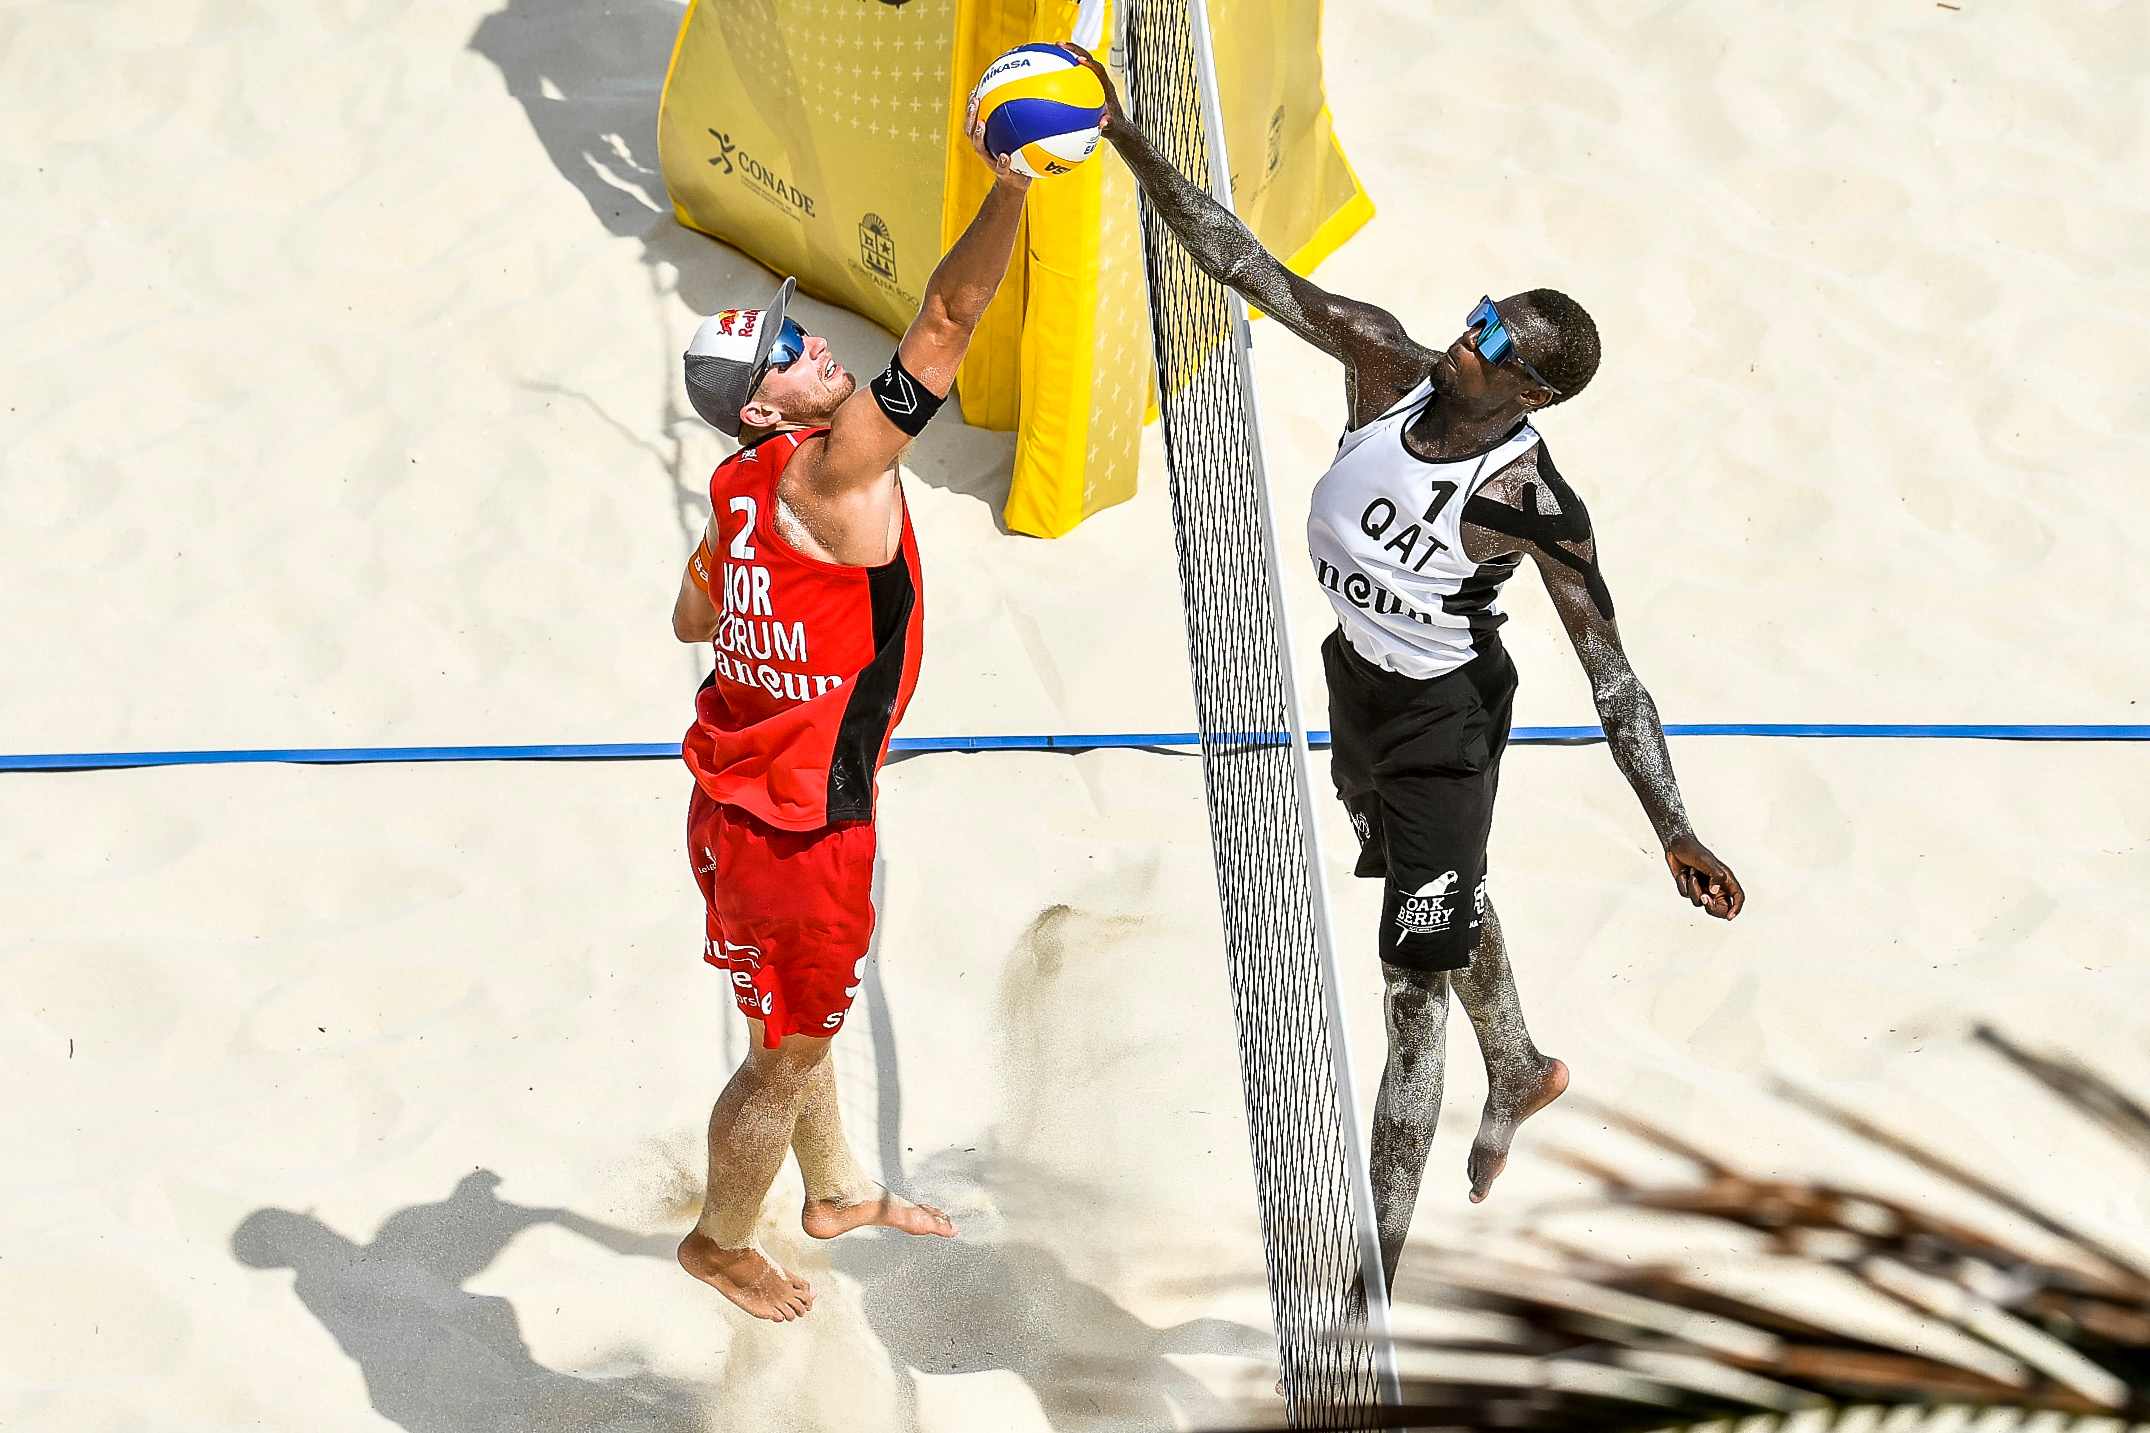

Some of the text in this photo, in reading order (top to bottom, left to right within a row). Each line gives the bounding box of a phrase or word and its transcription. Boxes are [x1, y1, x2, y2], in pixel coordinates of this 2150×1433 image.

[738, 151, 816, 218] CONADE
[729, 496, 757, 560] 2
[1422, 480, 1459, 524] 1
[1360, 497, 1449, 573] QAT
[723, 562, 773, 616] NOR
[715, 651, 844, 702] ancun
[1397, 905, 1455, 926] BERRY
[1406, 897, 1446, 912] OAK
